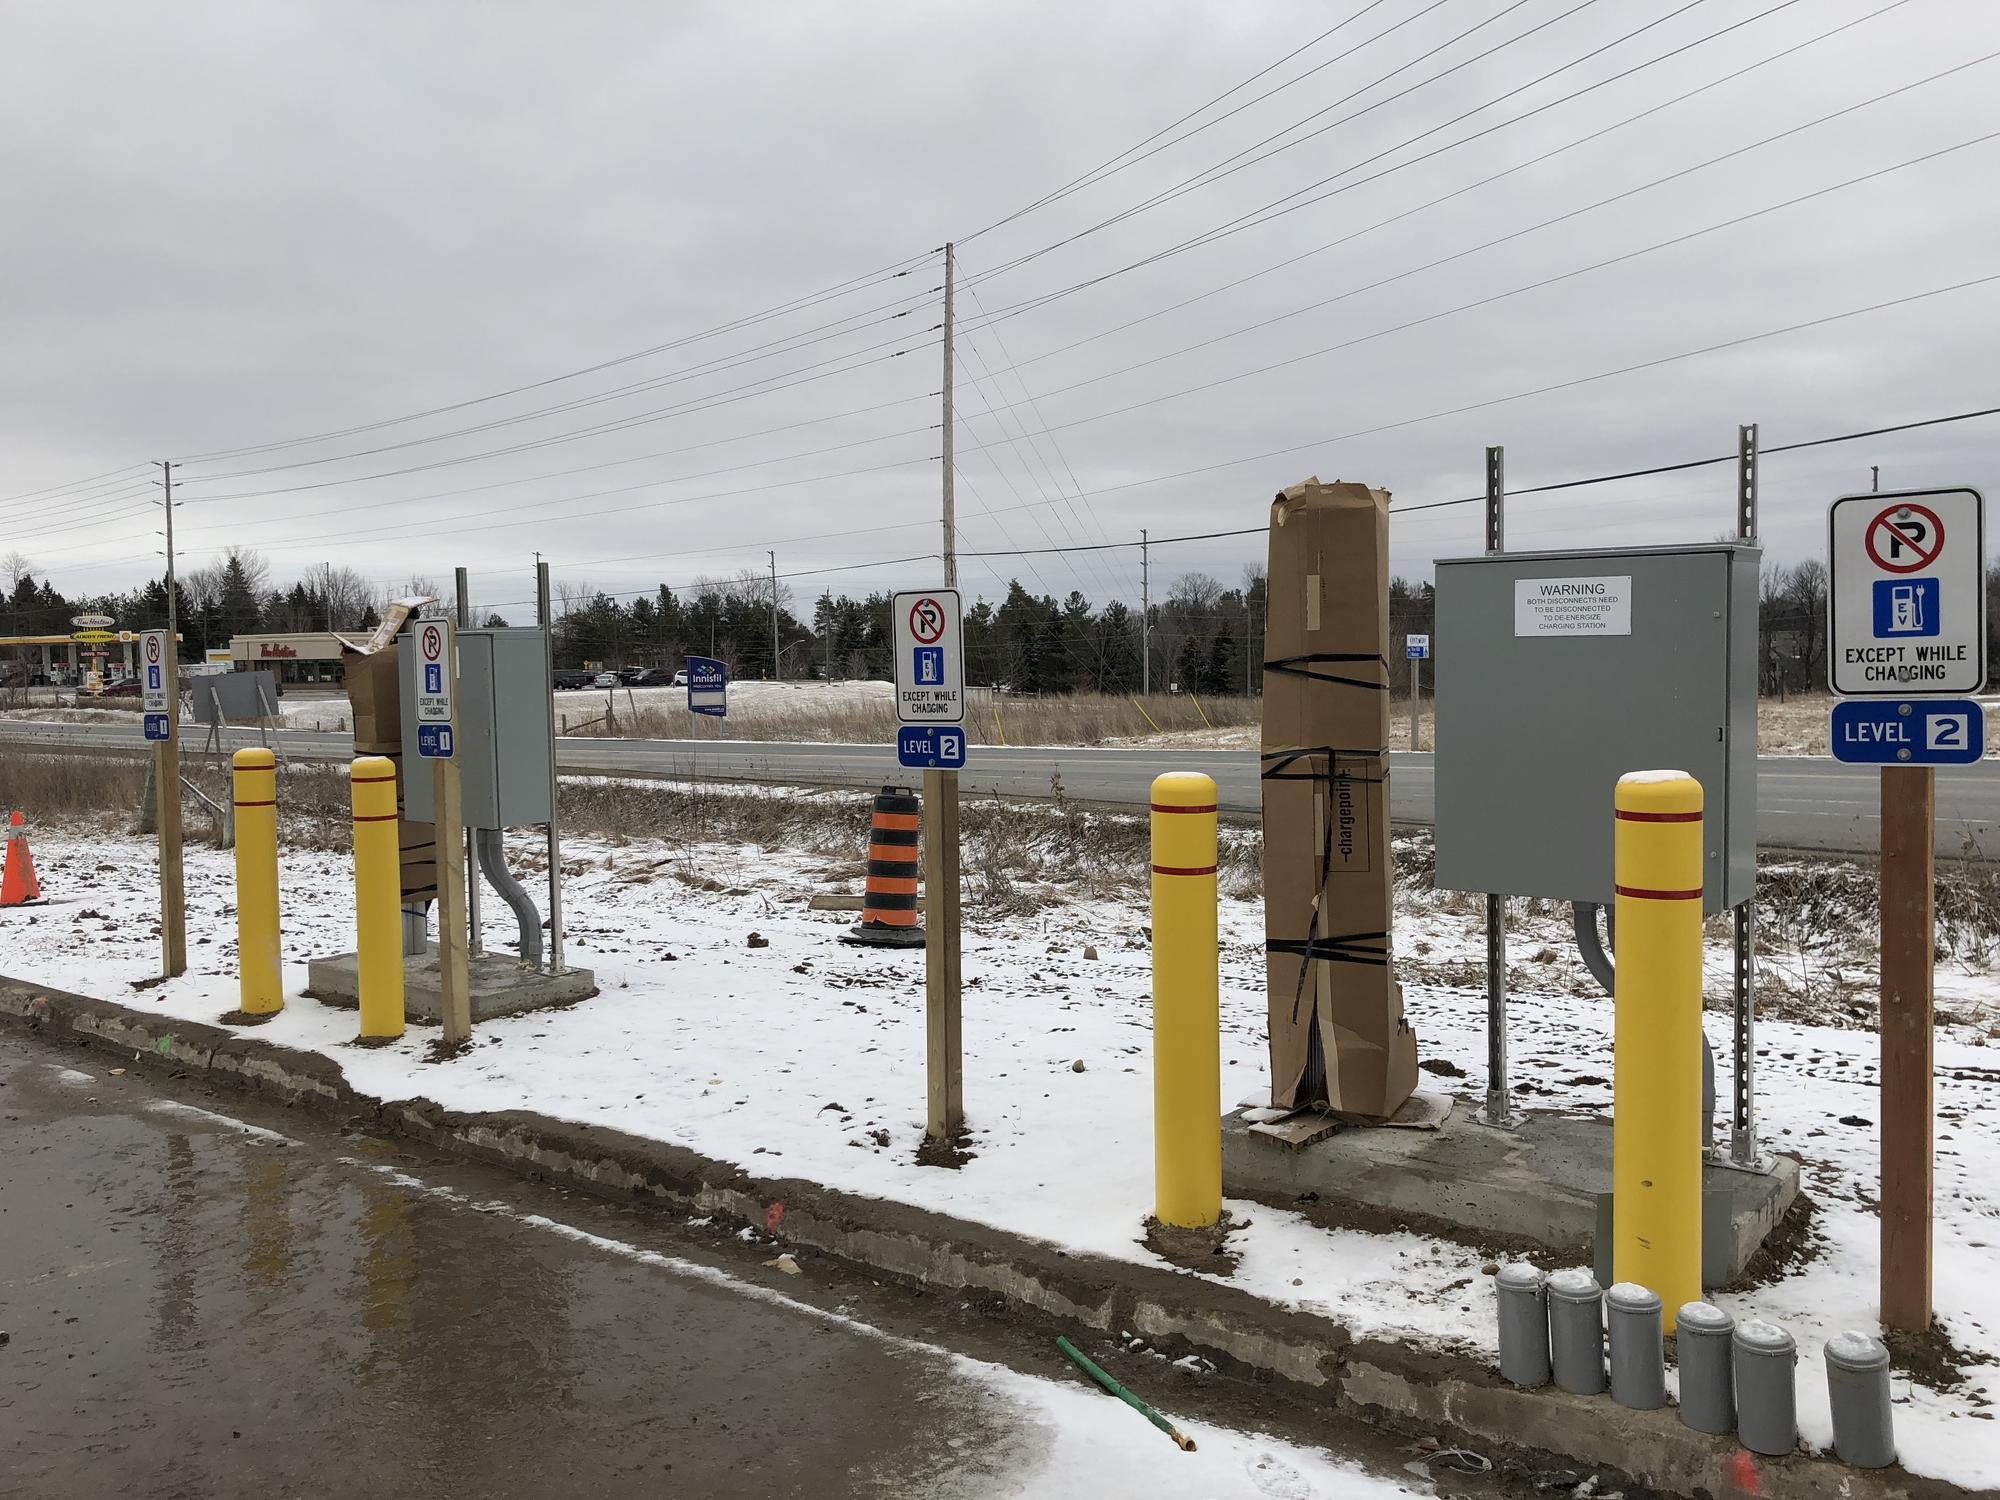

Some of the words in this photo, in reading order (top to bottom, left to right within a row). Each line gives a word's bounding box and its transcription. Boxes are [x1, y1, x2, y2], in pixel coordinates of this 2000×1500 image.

[1540, 584, 1605, 595] WARNING
[1845, 647, 1906, 664] EXCEPT
[1915, 645, 1967, 661] WHILE
[692, 674, 722, 683] Innisfil
[902, 691, 930, 701] EXCEPT
[934, 691, 957, 701] WHILE
[1845, 722, 1911, 742] LEVEL
[1934, 718, 1960, 745] 2
[420, 735, 437, 746] LEVEL
[903, 740, 934, 754] LEVEL
[943, 738, 956, 756] 2
